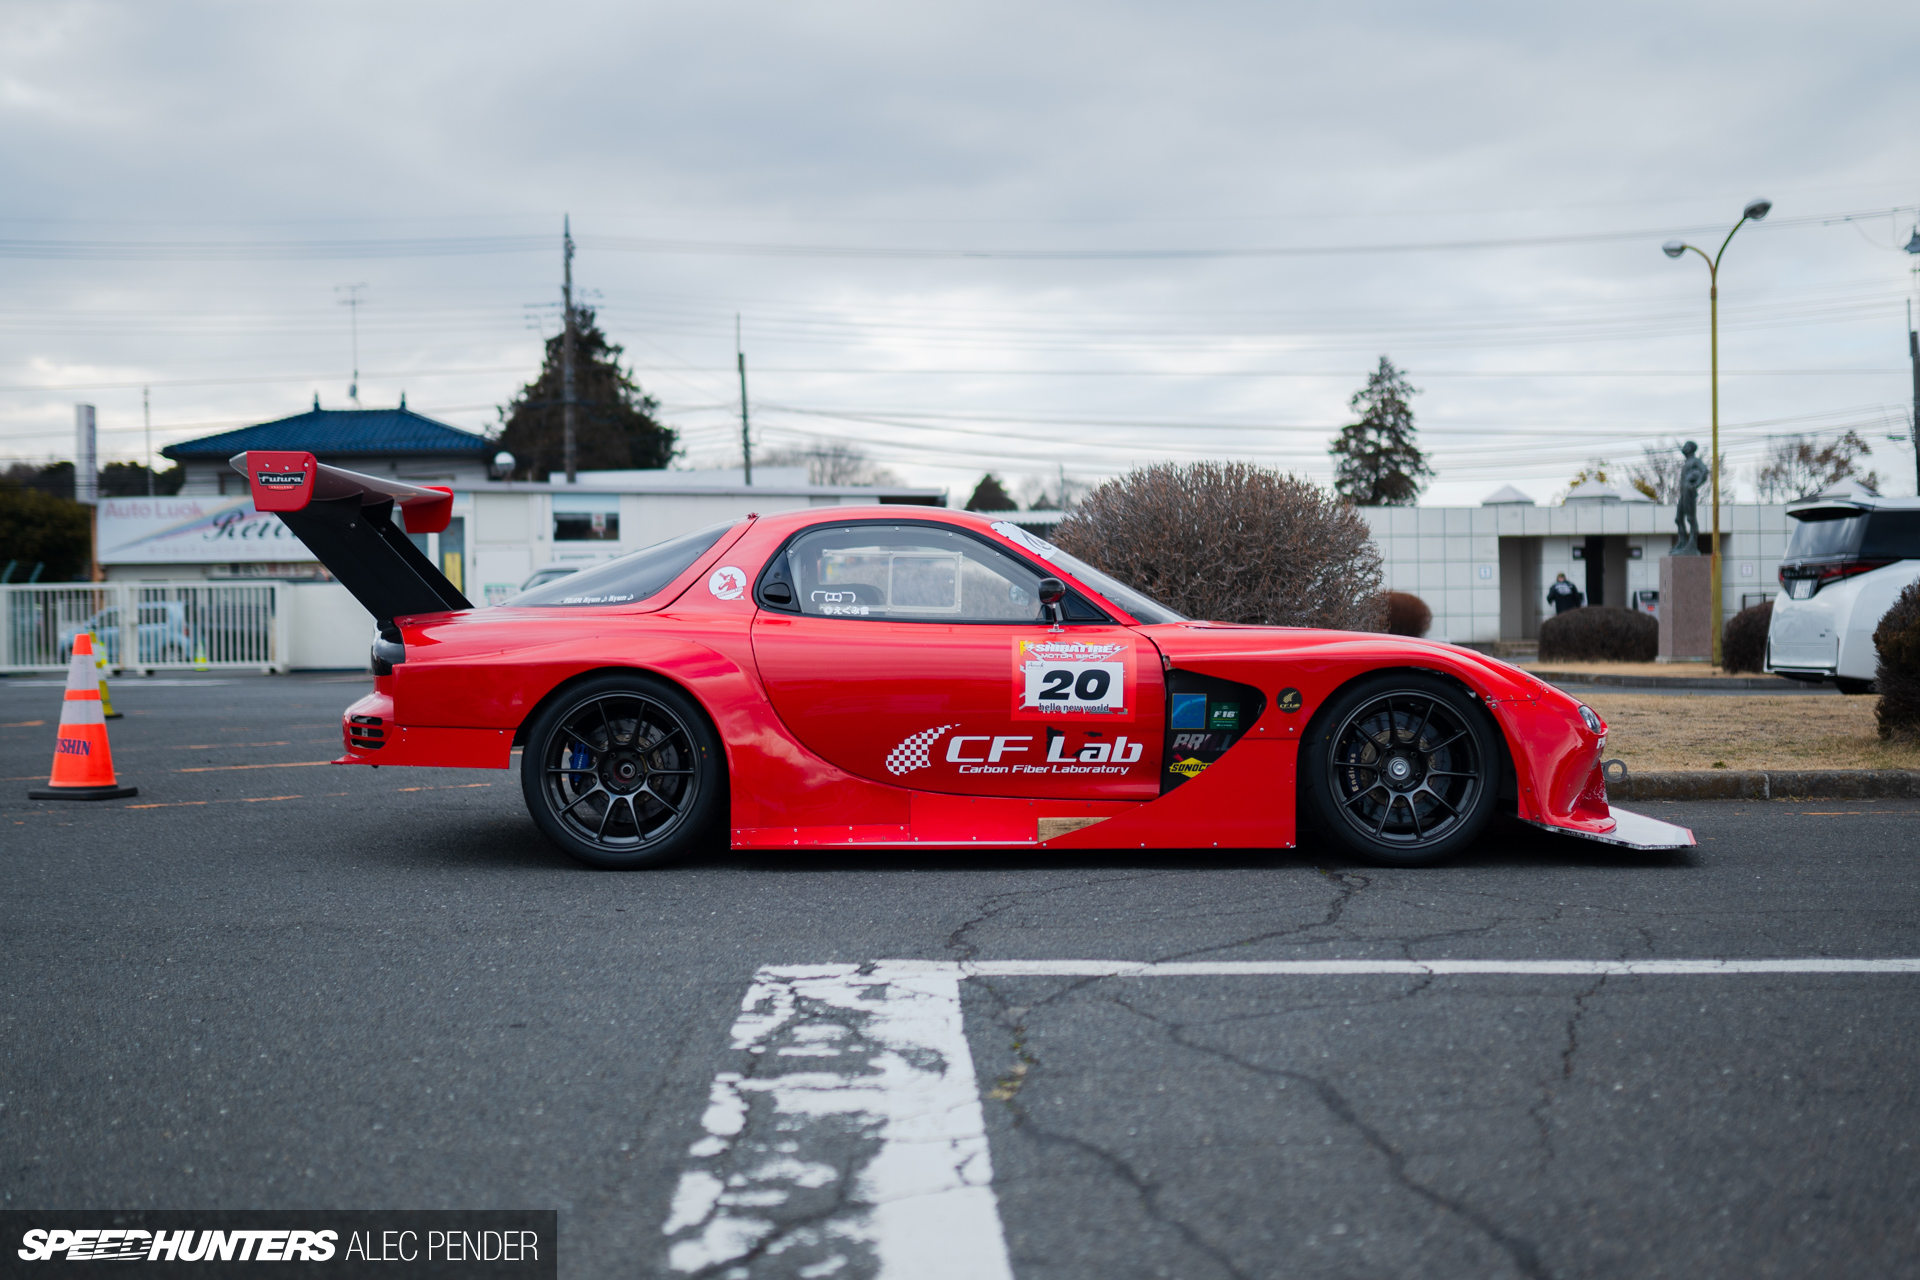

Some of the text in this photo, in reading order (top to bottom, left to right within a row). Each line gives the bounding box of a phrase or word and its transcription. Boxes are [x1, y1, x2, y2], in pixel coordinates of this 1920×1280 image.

[260, 475, 303, 483] Futura
[103, 502, 150, 519] Auto
[1035, 643, 1114, 653] SHIBATIRE
[1038, 669, 1111, 701] 20
[1038, 702, 1061, 712] hello
[1083, 703, 1110, 713] world
[945, 736, 1144, 763] CF Lab
[958, 764, 1130, 776] Carbon Fiber Laboratory
